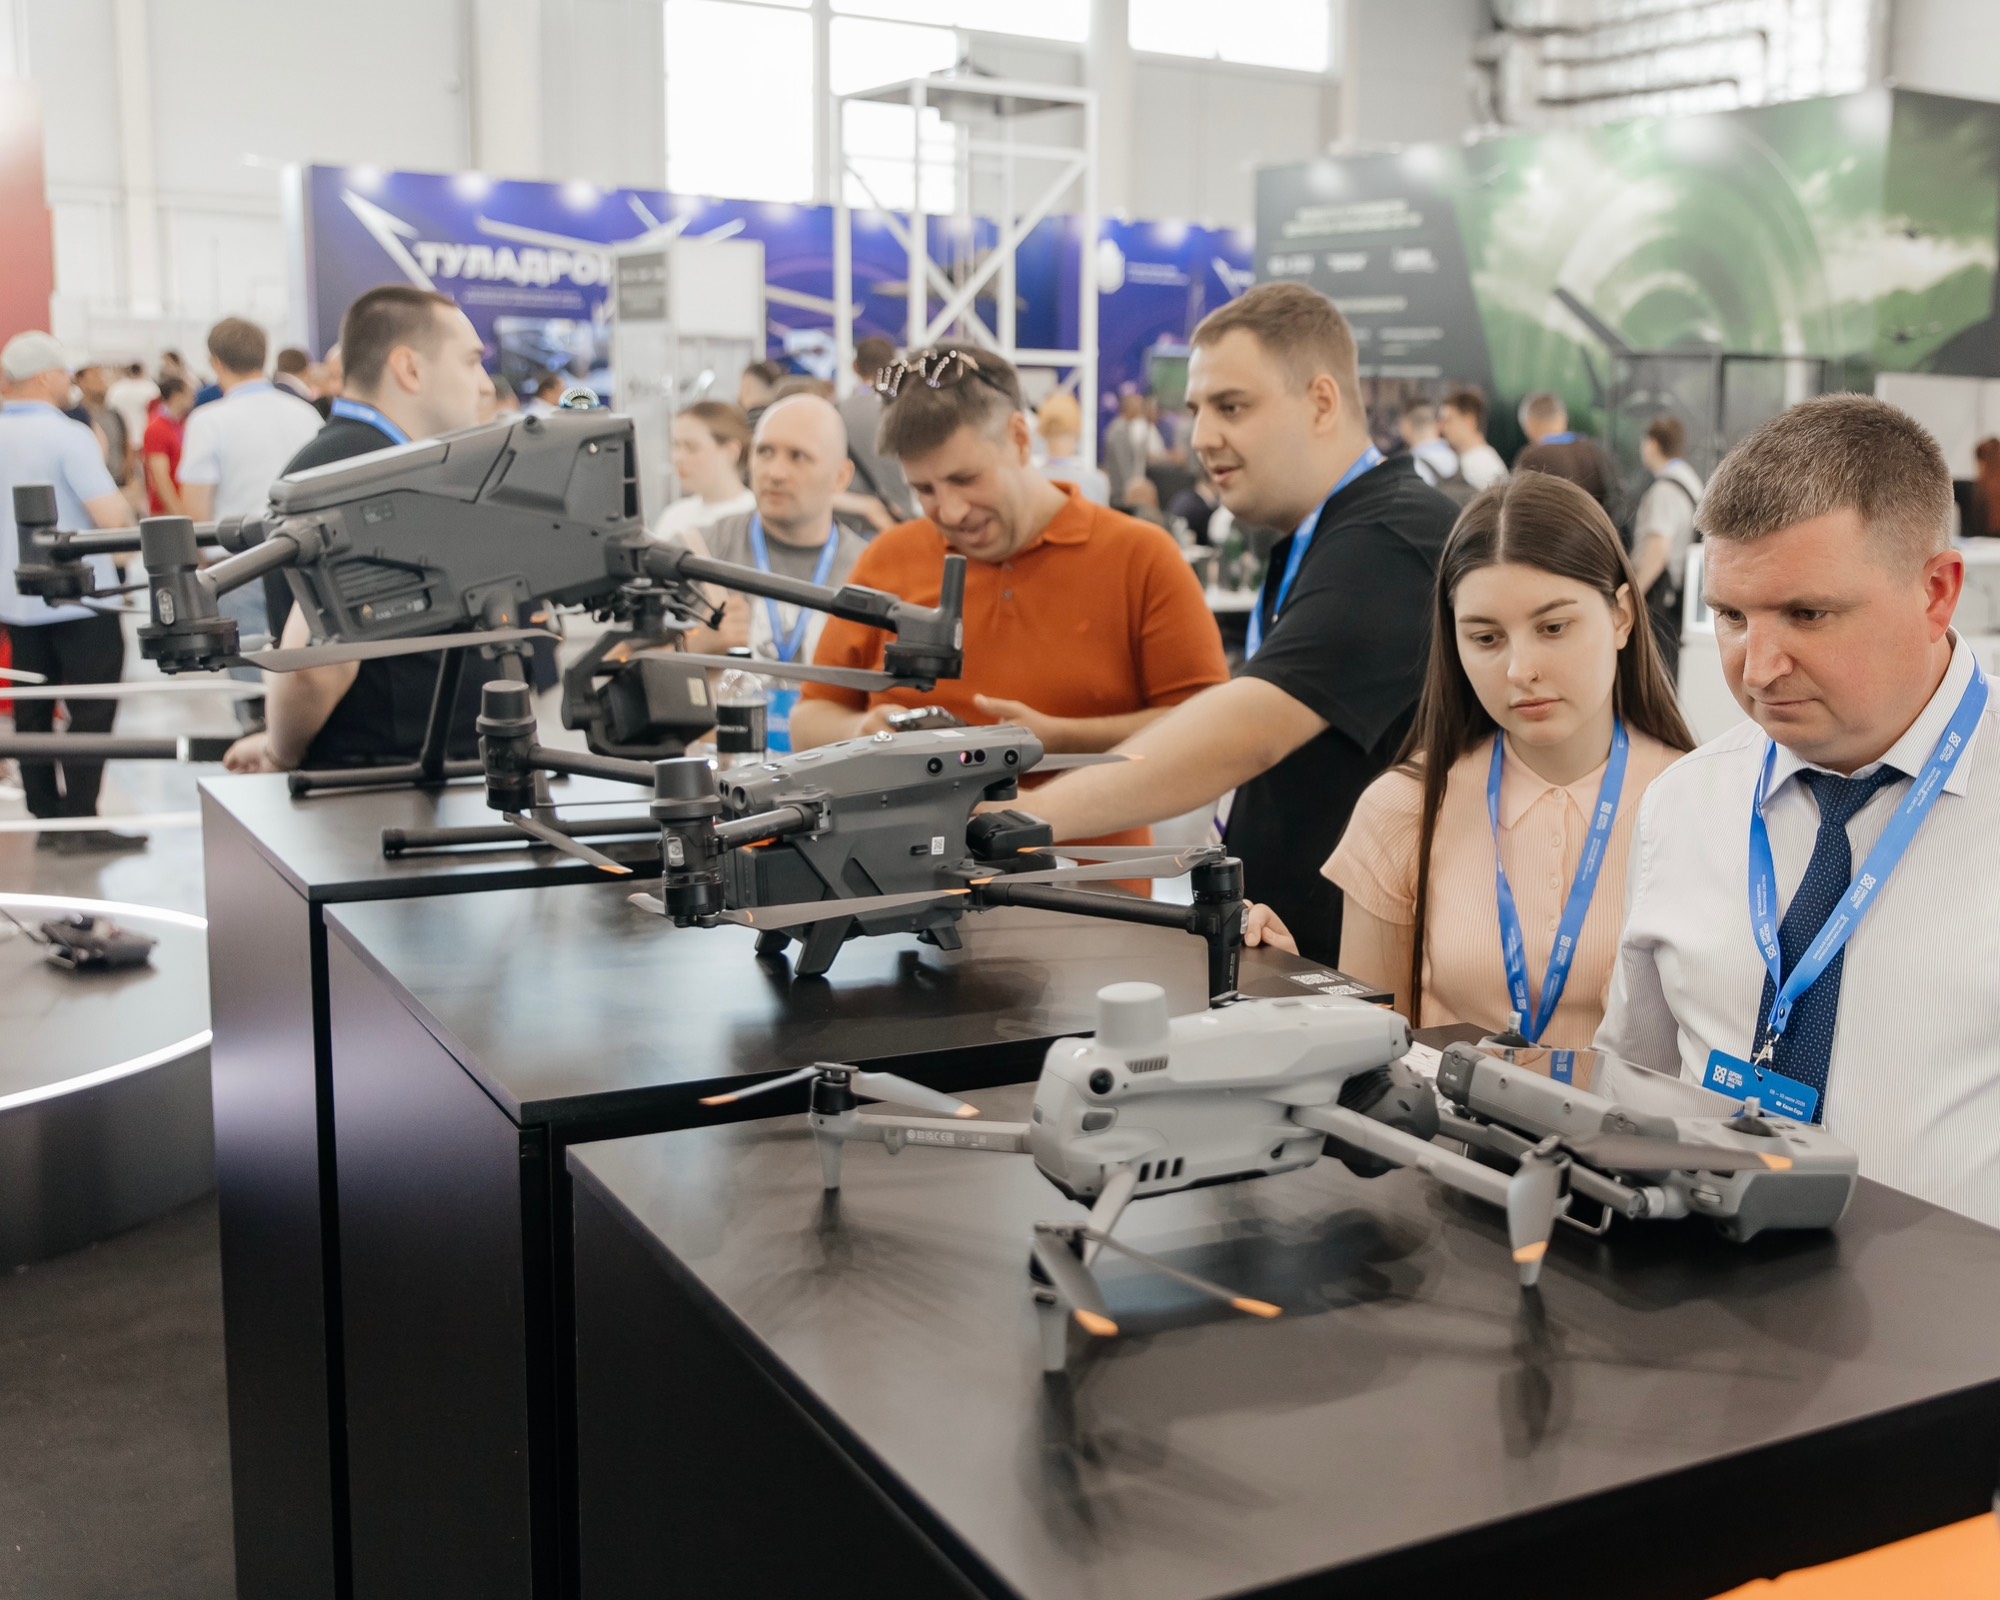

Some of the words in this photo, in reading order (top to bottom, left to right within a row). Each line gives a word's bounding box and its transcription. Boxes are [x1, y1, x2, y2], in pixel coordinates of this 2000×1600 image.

[413, 241, 614, 287] ТУЛАДРО
[1938, 742, 1951, 760] ЭКСПО
[1943, 745, 1955, 762] ДРОН
[1849, 884, 1863, 902] EXPO
[1852, 888, 1868, 909] DRONE
[1758, 927, 1767, 944] ДРОН
[1726, 1076, 1742, 1086] ЭКСПО
[1728, 1071, 1742, 1080] ДРОН
[1782, 1103, 1793, 1111] Kazan
[1793, 1107, 1803, 1115] Expo
